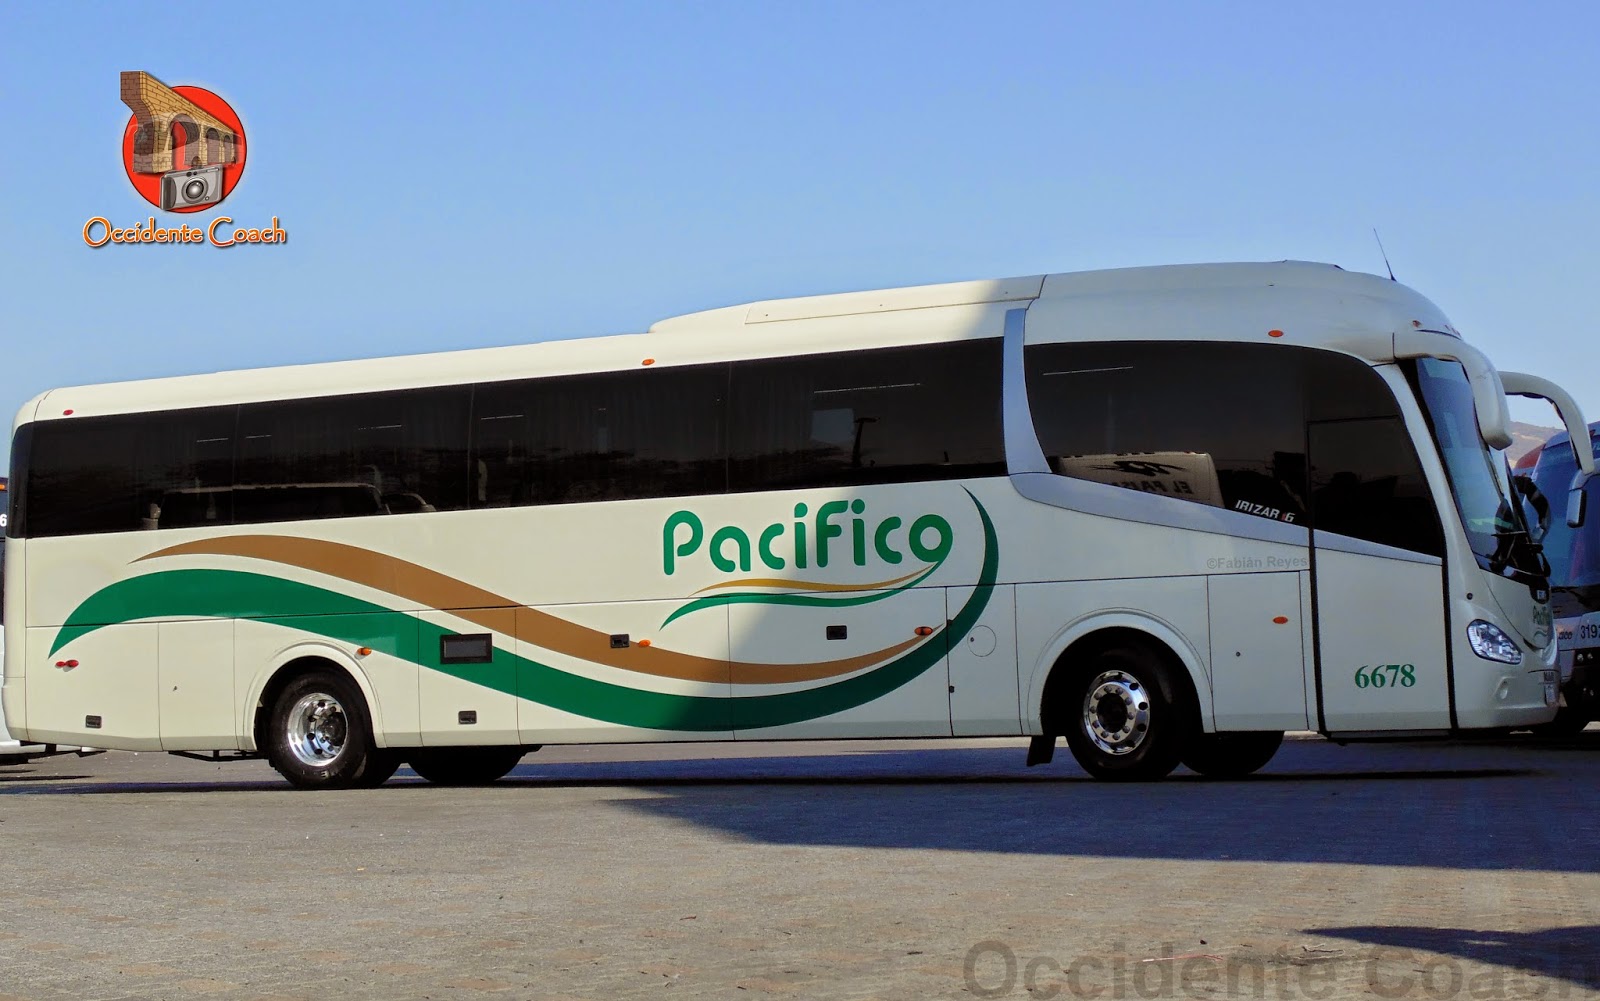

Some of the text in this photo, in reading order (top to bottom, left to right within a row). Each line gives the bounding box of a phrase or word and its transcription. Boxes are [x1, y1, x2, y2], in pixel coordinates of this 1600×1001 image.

[1235, 500, 1280, 519] IRIZAR
[1581, 624, 1600, 639] 319
[1354, 663, 1416, 689] 6678
